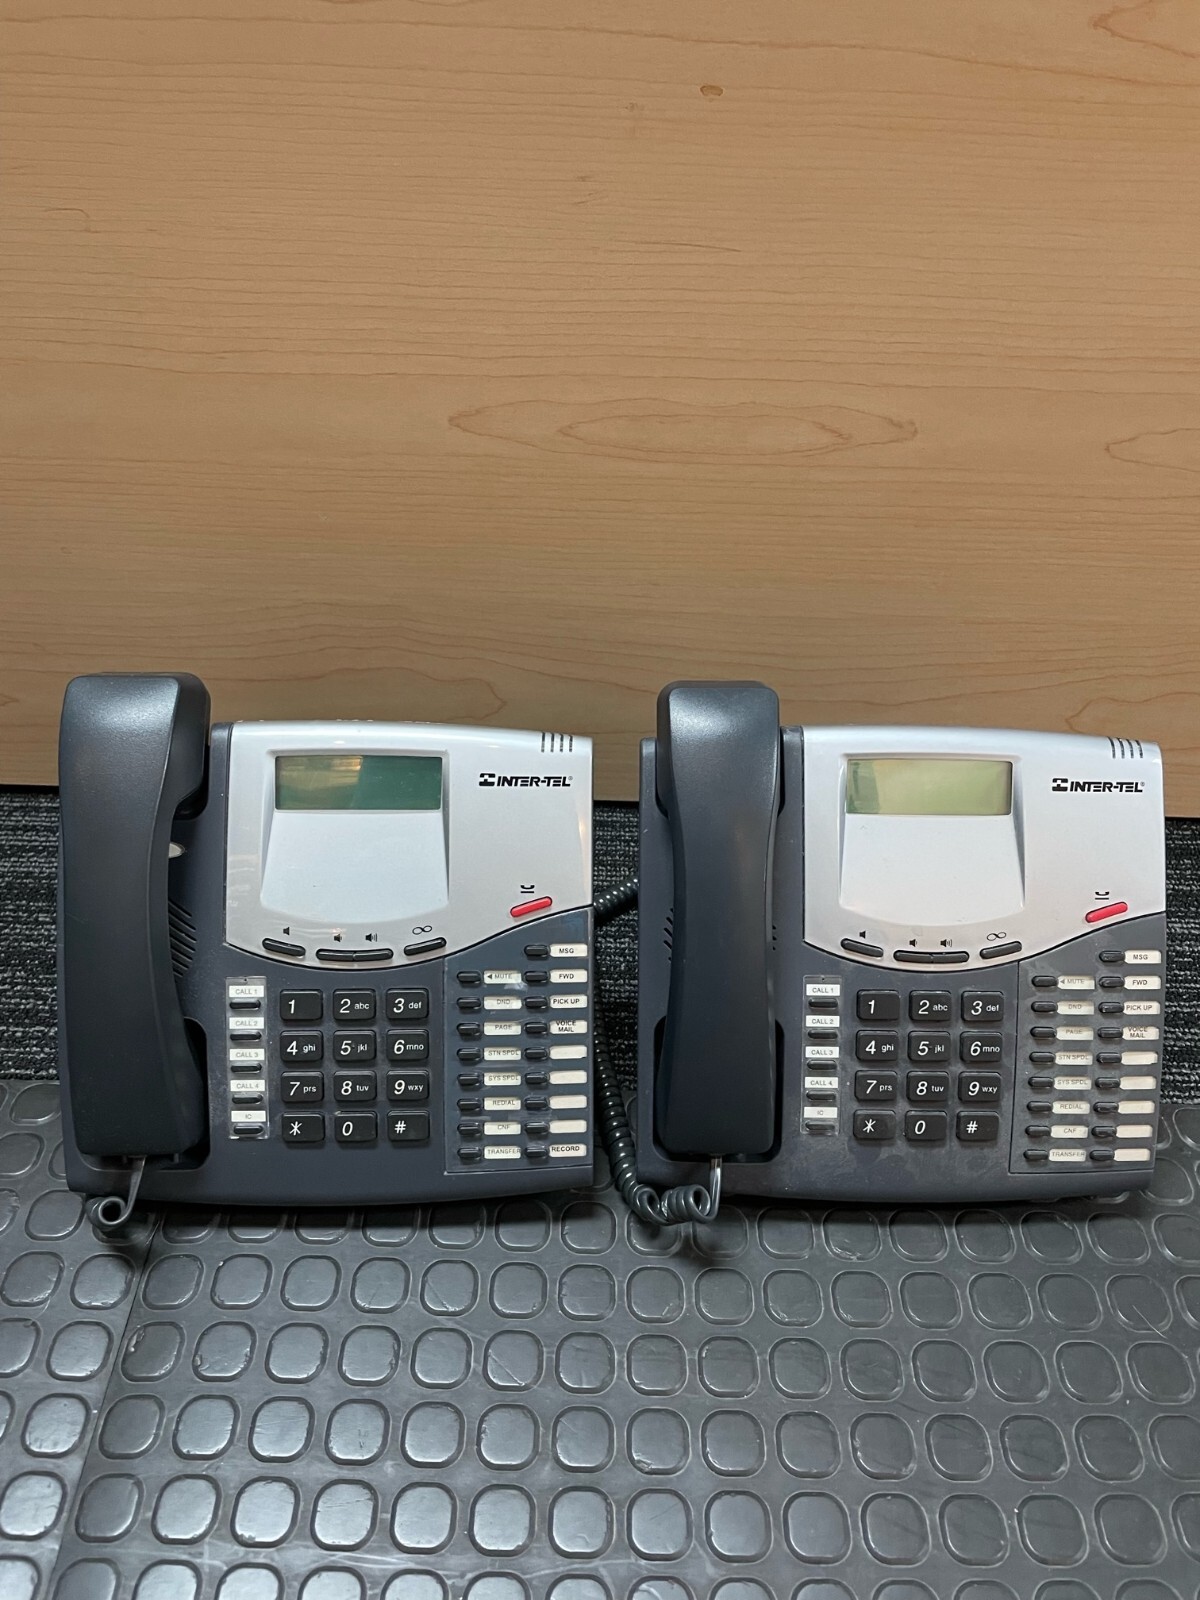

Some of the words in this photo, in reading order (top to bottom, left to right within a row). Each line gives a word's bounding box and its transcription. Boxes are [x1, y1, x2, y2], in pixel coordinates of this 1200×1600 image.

[288, 999, 296, 1014] 1
[340, 999, 350, 1013] 2
[354, 1002, 370, 1010] abc
[393, 998, 405, 1013] 3
[408, 1001, 422, 1009] def
[869, 1000, 876, 1014] 1
[918, 1000, 930, 1015] 2
[932, 1003, 948, 1012] abc
[971, 1001, 982, 1015] 3
[986, 1004, 999, 1012] def
[286, 1041, 298, 1056] 4
[303, 1044, 316, 1053] ghi
[340, 1041, 351, 1055] 5
[357, 1044, 368, 1052] jkl
[394, 1040, 405, 1054] 6
[865, 1040, 876, 1055] 4
[881, 1044, 894, 1053] ghi
[918, 1041, 929, 1056] 5
[934, 1044, 945, 1053] jkl
[970, 1041, 981, 1056] 6
[982, 1045, 1000, 1053] mno
[289, 1082, 300, 1096] 7
[303, 1085, 317, 1094] prs
[341, 1081, 352, 1095] 8
[356, 1084, 369, 1092] tuv
[394, 1080, 405, 1095] 9
[408, 1084, 424, 1093] wxy
[866, 1080, 877, 1094] 7
[879, 1084, 892, 1092] prs
[916, 1081, 928, 1095] 8
[931, 1085, 944, 1093] tuv
[968, 1081, 980, 1096] 9
[982, 1085, 998, 1094] wxy
[342, 1122, 353, 1136] 0
[395, 1120, 406, 1134] #
[915, 1120, 926, 1135] 0
[966, 1121, 978, 1134] #
